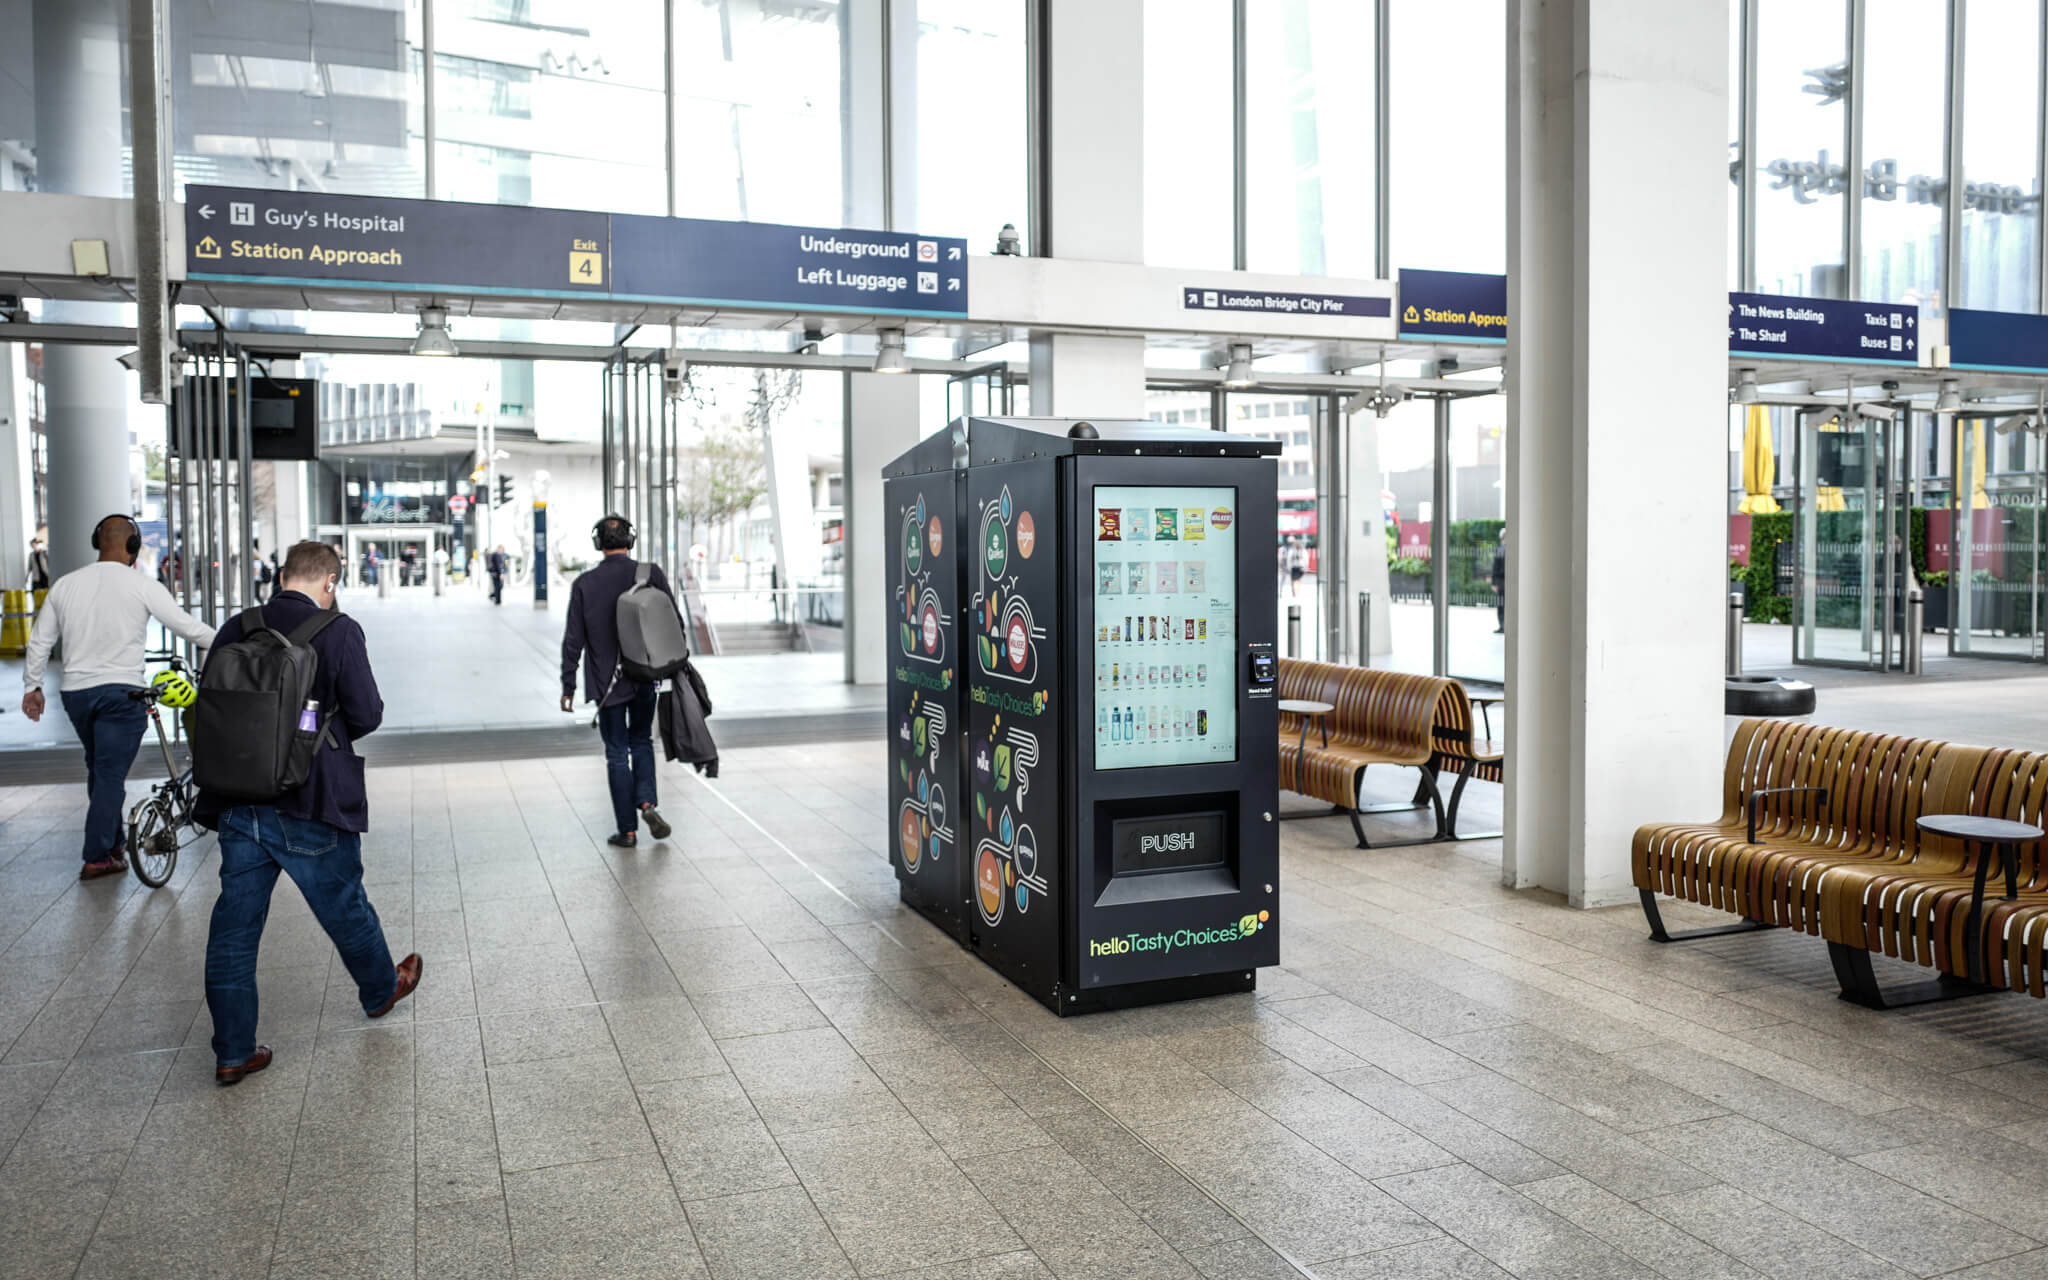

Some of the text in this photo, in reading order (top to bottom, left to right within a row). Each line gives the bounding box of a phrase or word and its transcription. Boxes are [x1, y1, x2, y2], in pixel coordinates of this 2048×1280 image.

[265, 209, 319, 230] Guy's
[324, 211, 404, 234] Hospital
[231, 239, 402, 267] Station Approach
[573, 239, 598, 252] Exit
[801, 235, 910, 259] Underground
[578, 259, 593, 277] 4
[798, 267, 908, 292] Left Luggage
[1222, 294, 1344, 313] London Bridge City Pier
[1424, 307, 1508, 328] Station Approa
[1739, 304, 1825, 324] The News Building
[1865, 313, 1888, 327] Taxis
[1739, 328, 1787, 343] The Shard
[1861, 336, 1888, 349] Buses
[1141, 832, 1195, 854] PUSH
